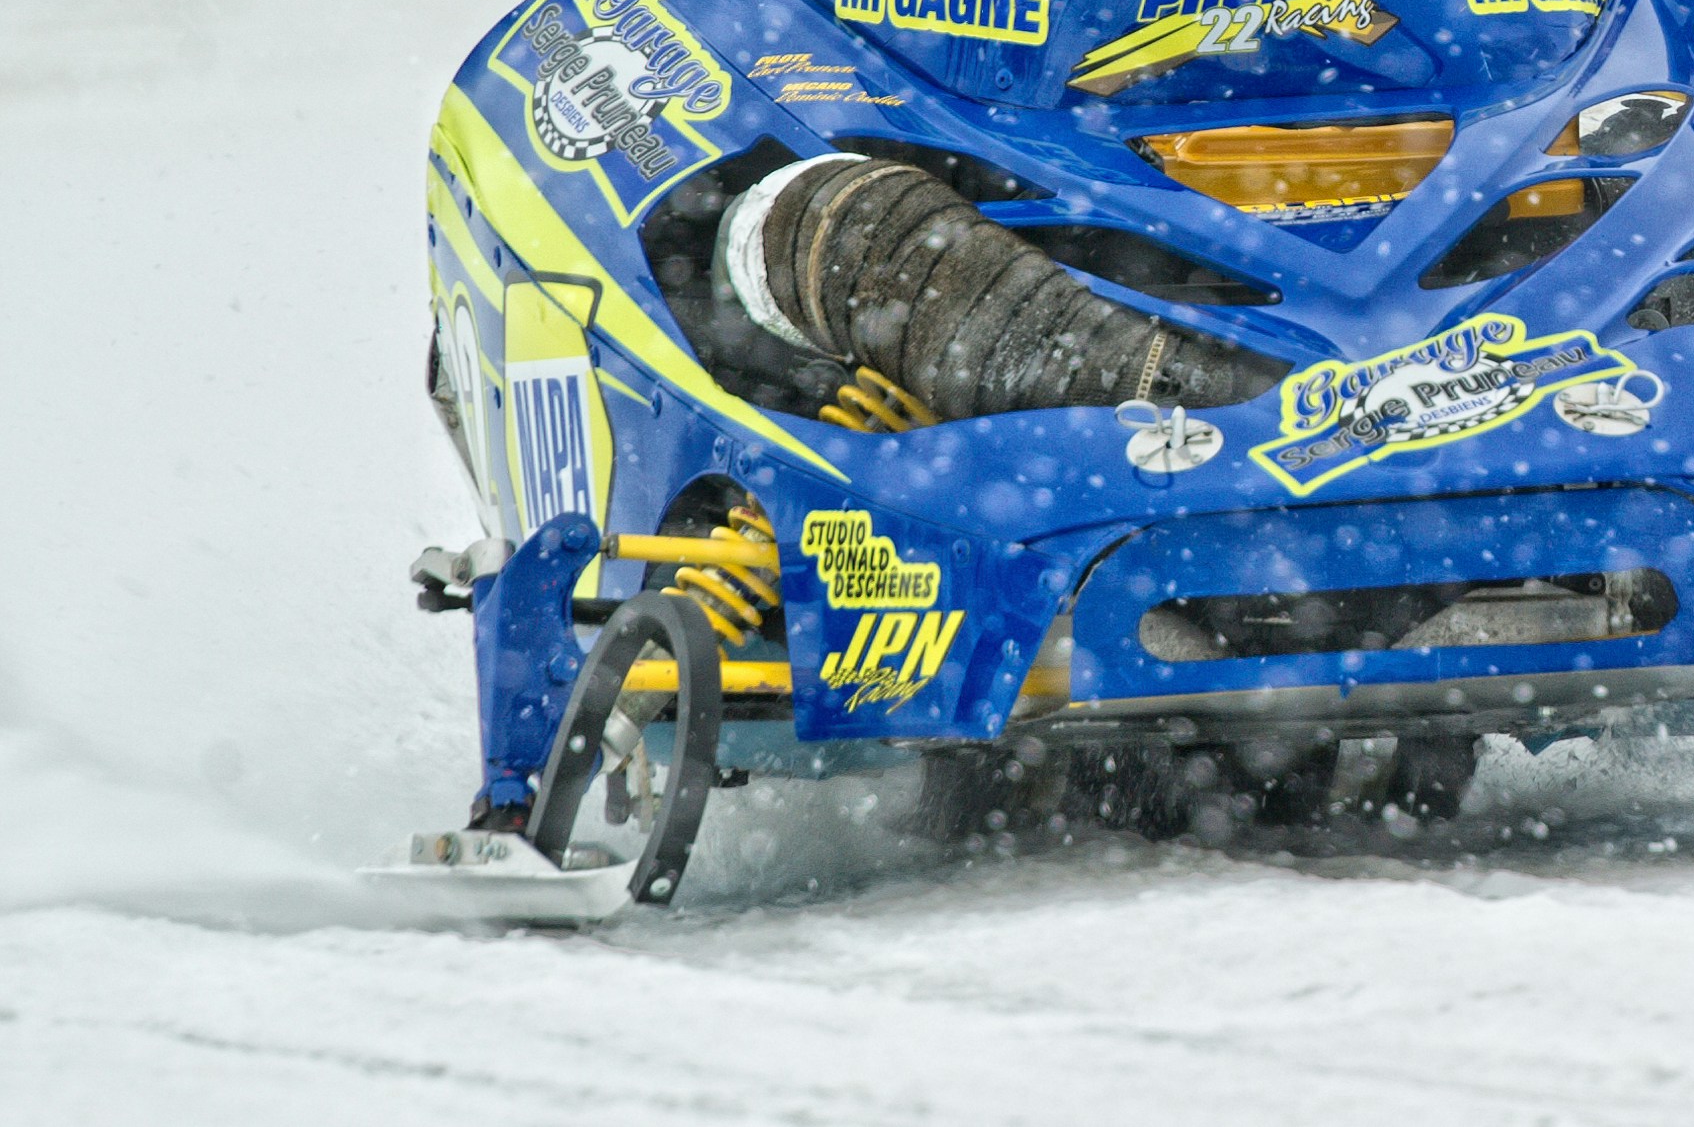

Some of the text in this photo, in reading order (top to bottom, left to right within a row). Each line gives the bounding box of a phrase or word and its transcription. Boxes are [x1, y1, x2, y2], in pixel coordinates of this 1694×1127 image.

[1197, 5, 1264, 53] 22
[522, 3, 677, 181] Serge Pruneau
[550, 90, 591, 134] DESBIENS
[1291, 319, 1515, 431] Garage
[1277, 345, 1593, 470] Serge Pruneau
[1420, 396, 1493, 424] DESBIENS
[807, 520, 866, 546] STUDIO
[823, 546, 890, 572] DONALD
[834, 565, 934, 599] DESCHÊNES
[819, 610, 966, 684] JPN
